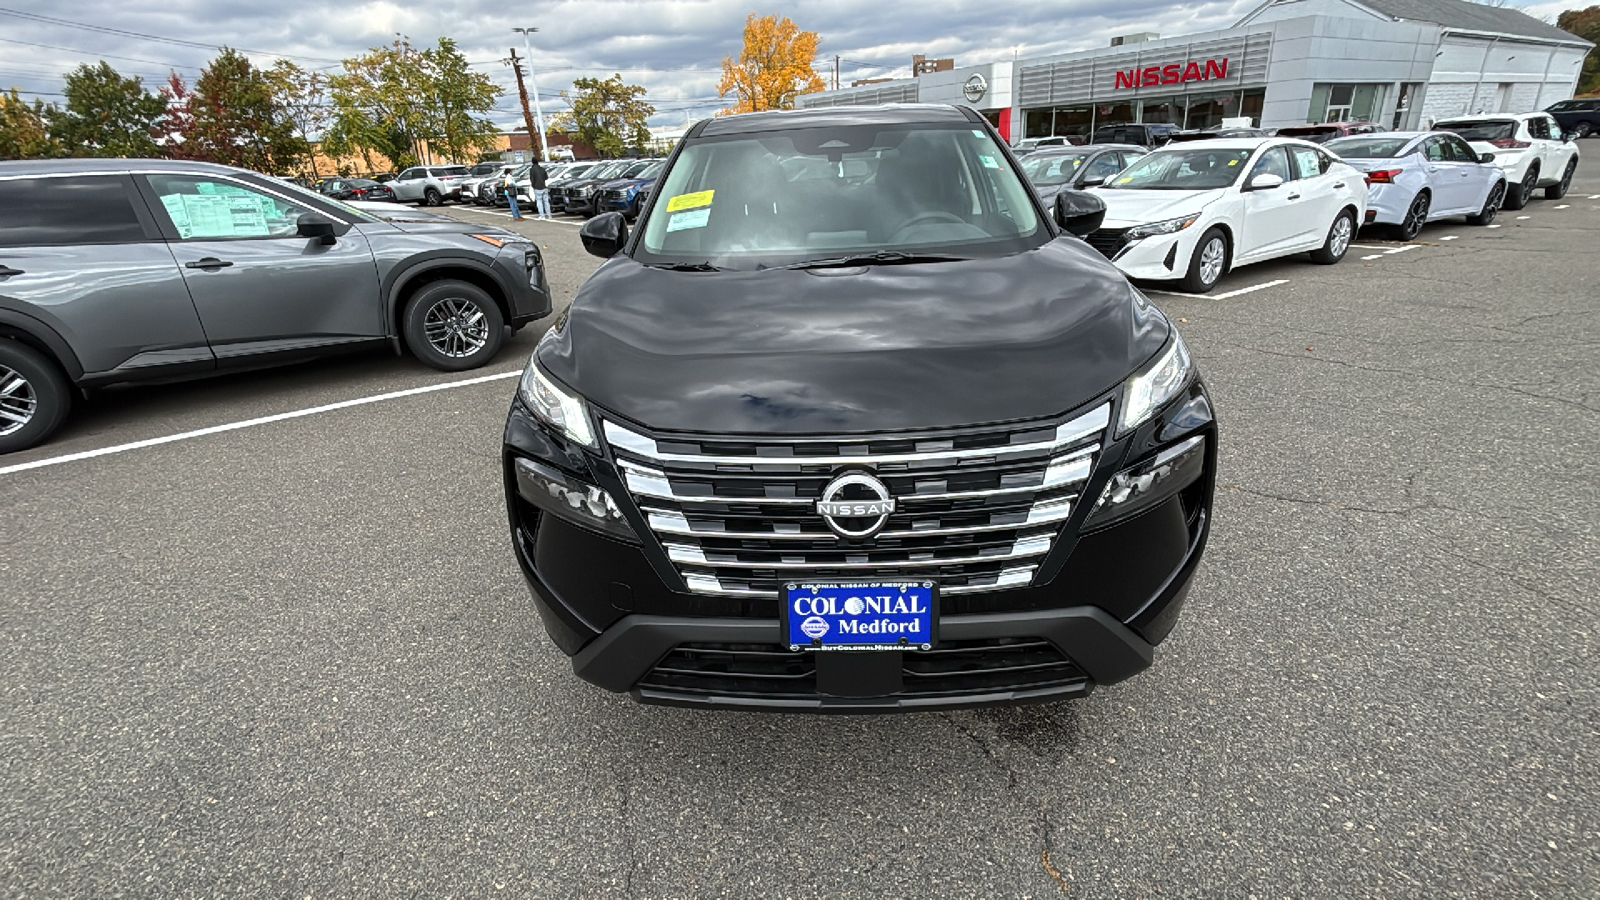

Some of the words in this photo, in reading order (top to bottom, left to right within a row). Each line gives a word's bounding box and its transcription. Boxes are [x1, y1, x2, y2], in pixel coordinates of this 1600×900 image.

[1115, 58, 1229, 90] NISSAN
[818, 502, 894, 515] NISSAN
[794, 596, 926, 615] COLONIAL
[838, 618, 921, 634] Medford
